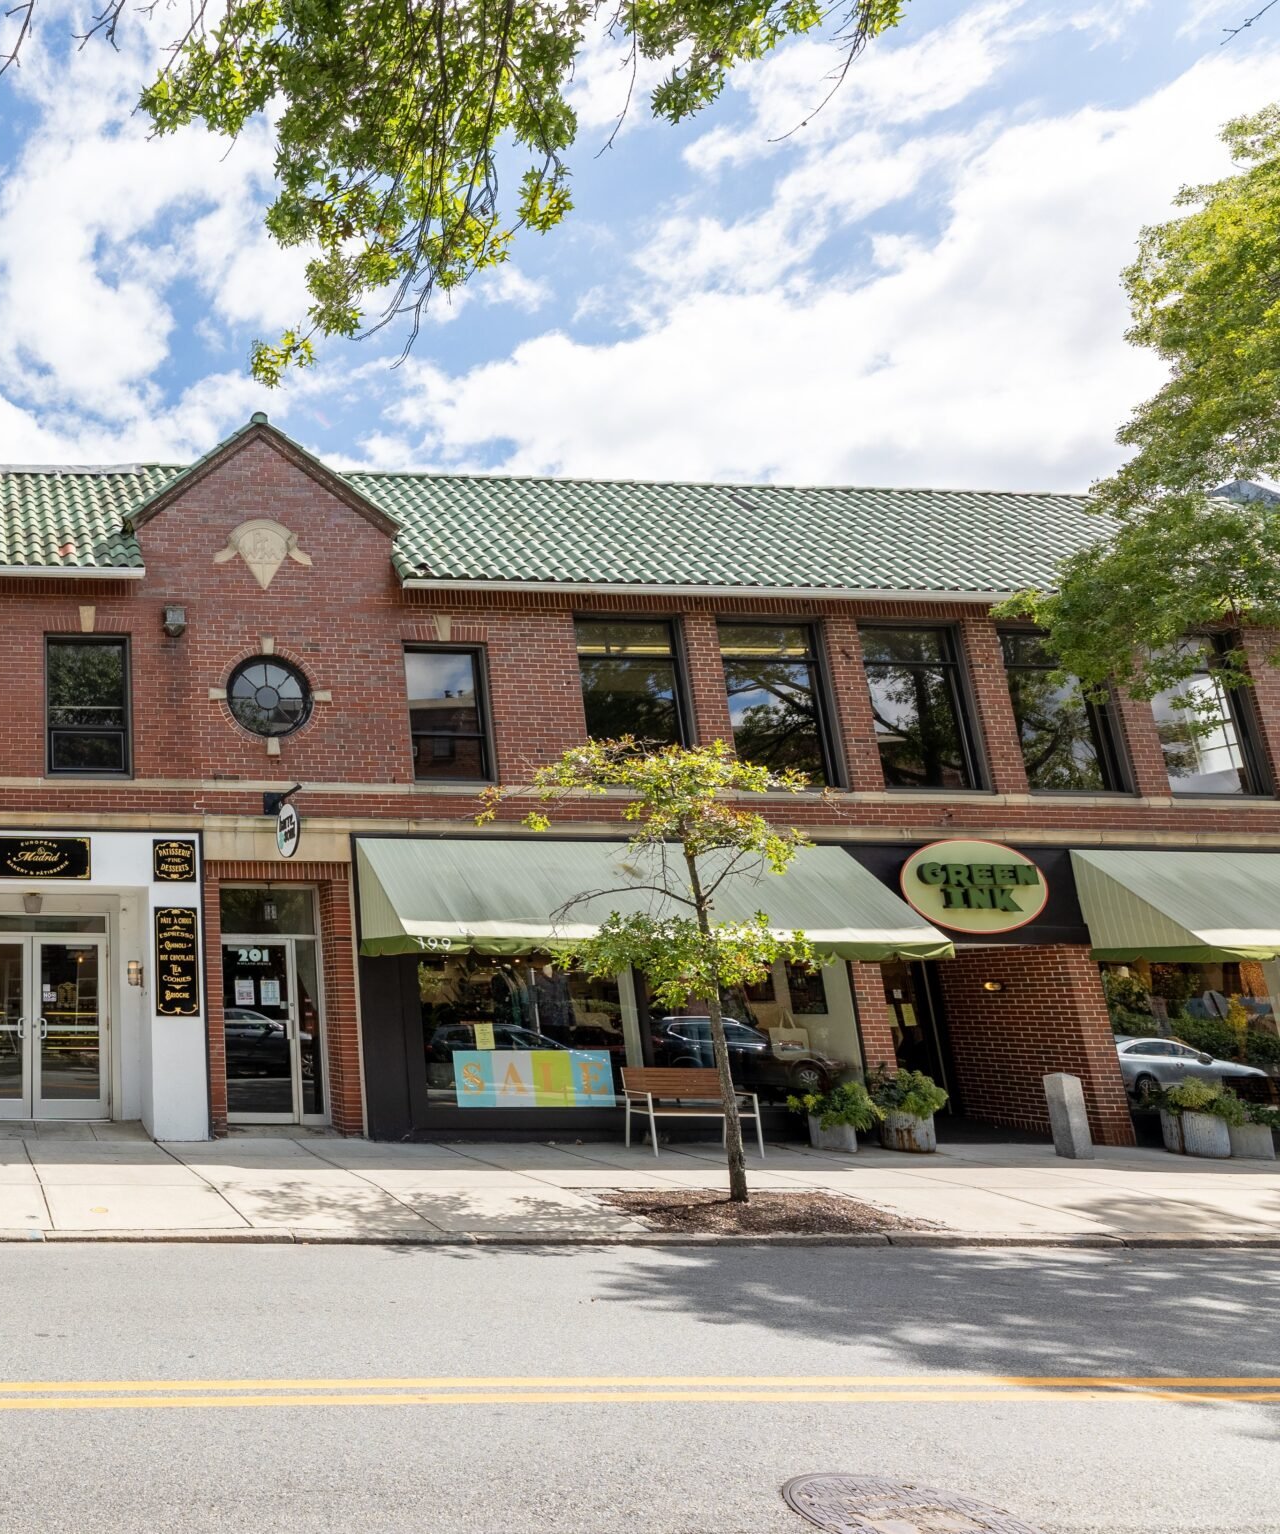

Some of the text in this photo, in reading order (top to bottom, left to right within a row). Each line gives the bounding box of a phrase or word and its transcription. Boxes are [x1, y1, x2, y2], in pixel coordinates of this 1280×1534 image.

[20, 840, 58, 848] EUROPEAN
[13, 851, 61, 862] Madrid
[6, 860, 28, 874] BAKERY
[160, 863, 190, 872] DESSERTS
[916, 862, 1040, 887] GREEN
[940, 886, 1024, 912] INK
[159, 931, 194, 939] ESPRESSO
[417, 936, 452, 952] 199
[238, 948, 270, 962] 201
[162, 974, 192, 982] COOKIES
[463, 1061, 609, 1096] SALE
